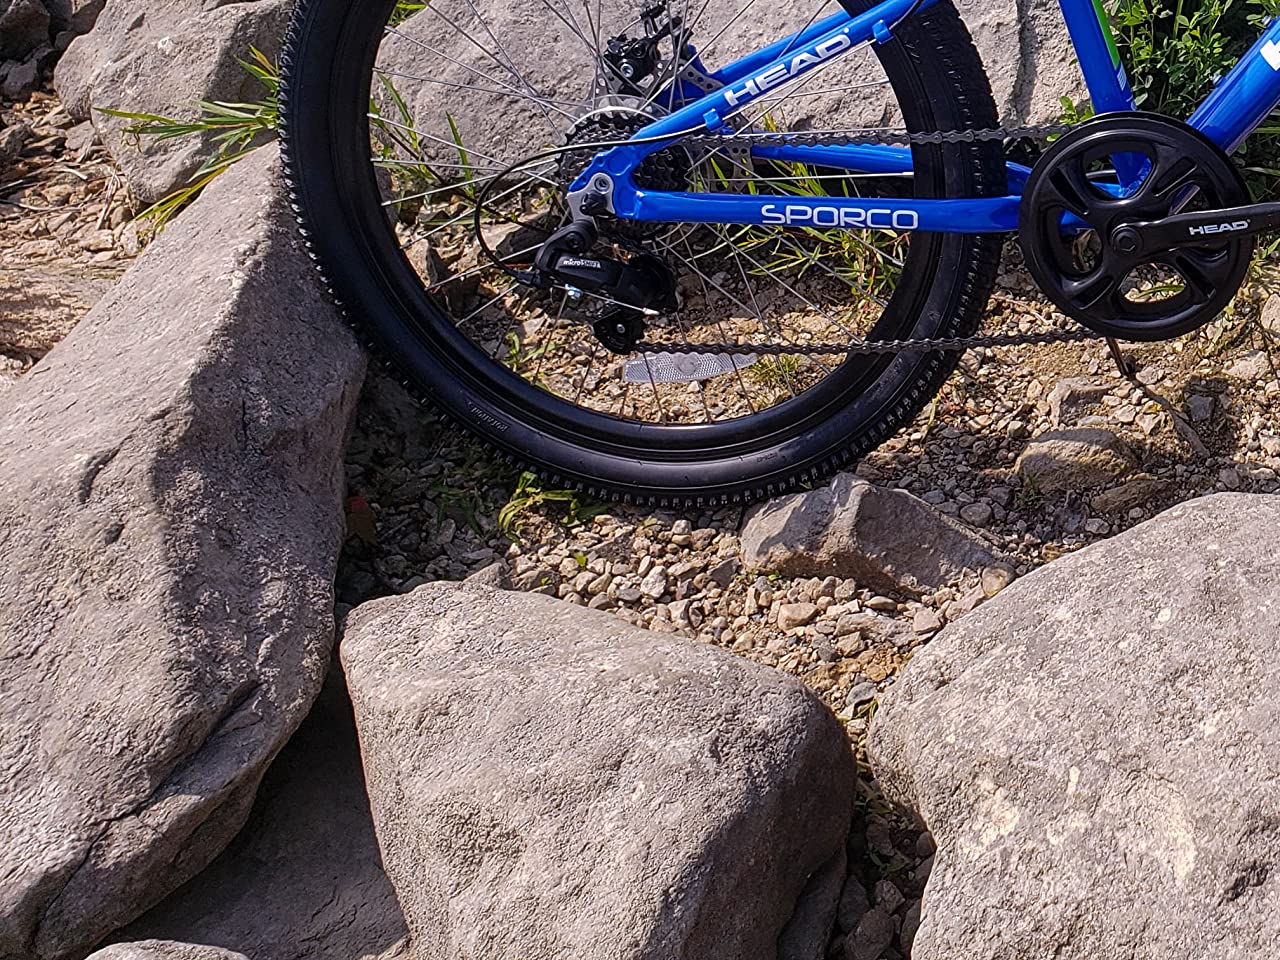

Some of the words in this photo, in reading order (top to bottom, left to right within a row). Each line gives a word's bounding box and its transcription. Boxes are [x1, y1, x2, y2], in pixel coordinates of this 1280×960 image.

[722, 33, 852, 107] HEAD
[760, 204, 919, 230] SPORCO
[1188, 220, 1250, 237] HEAD
